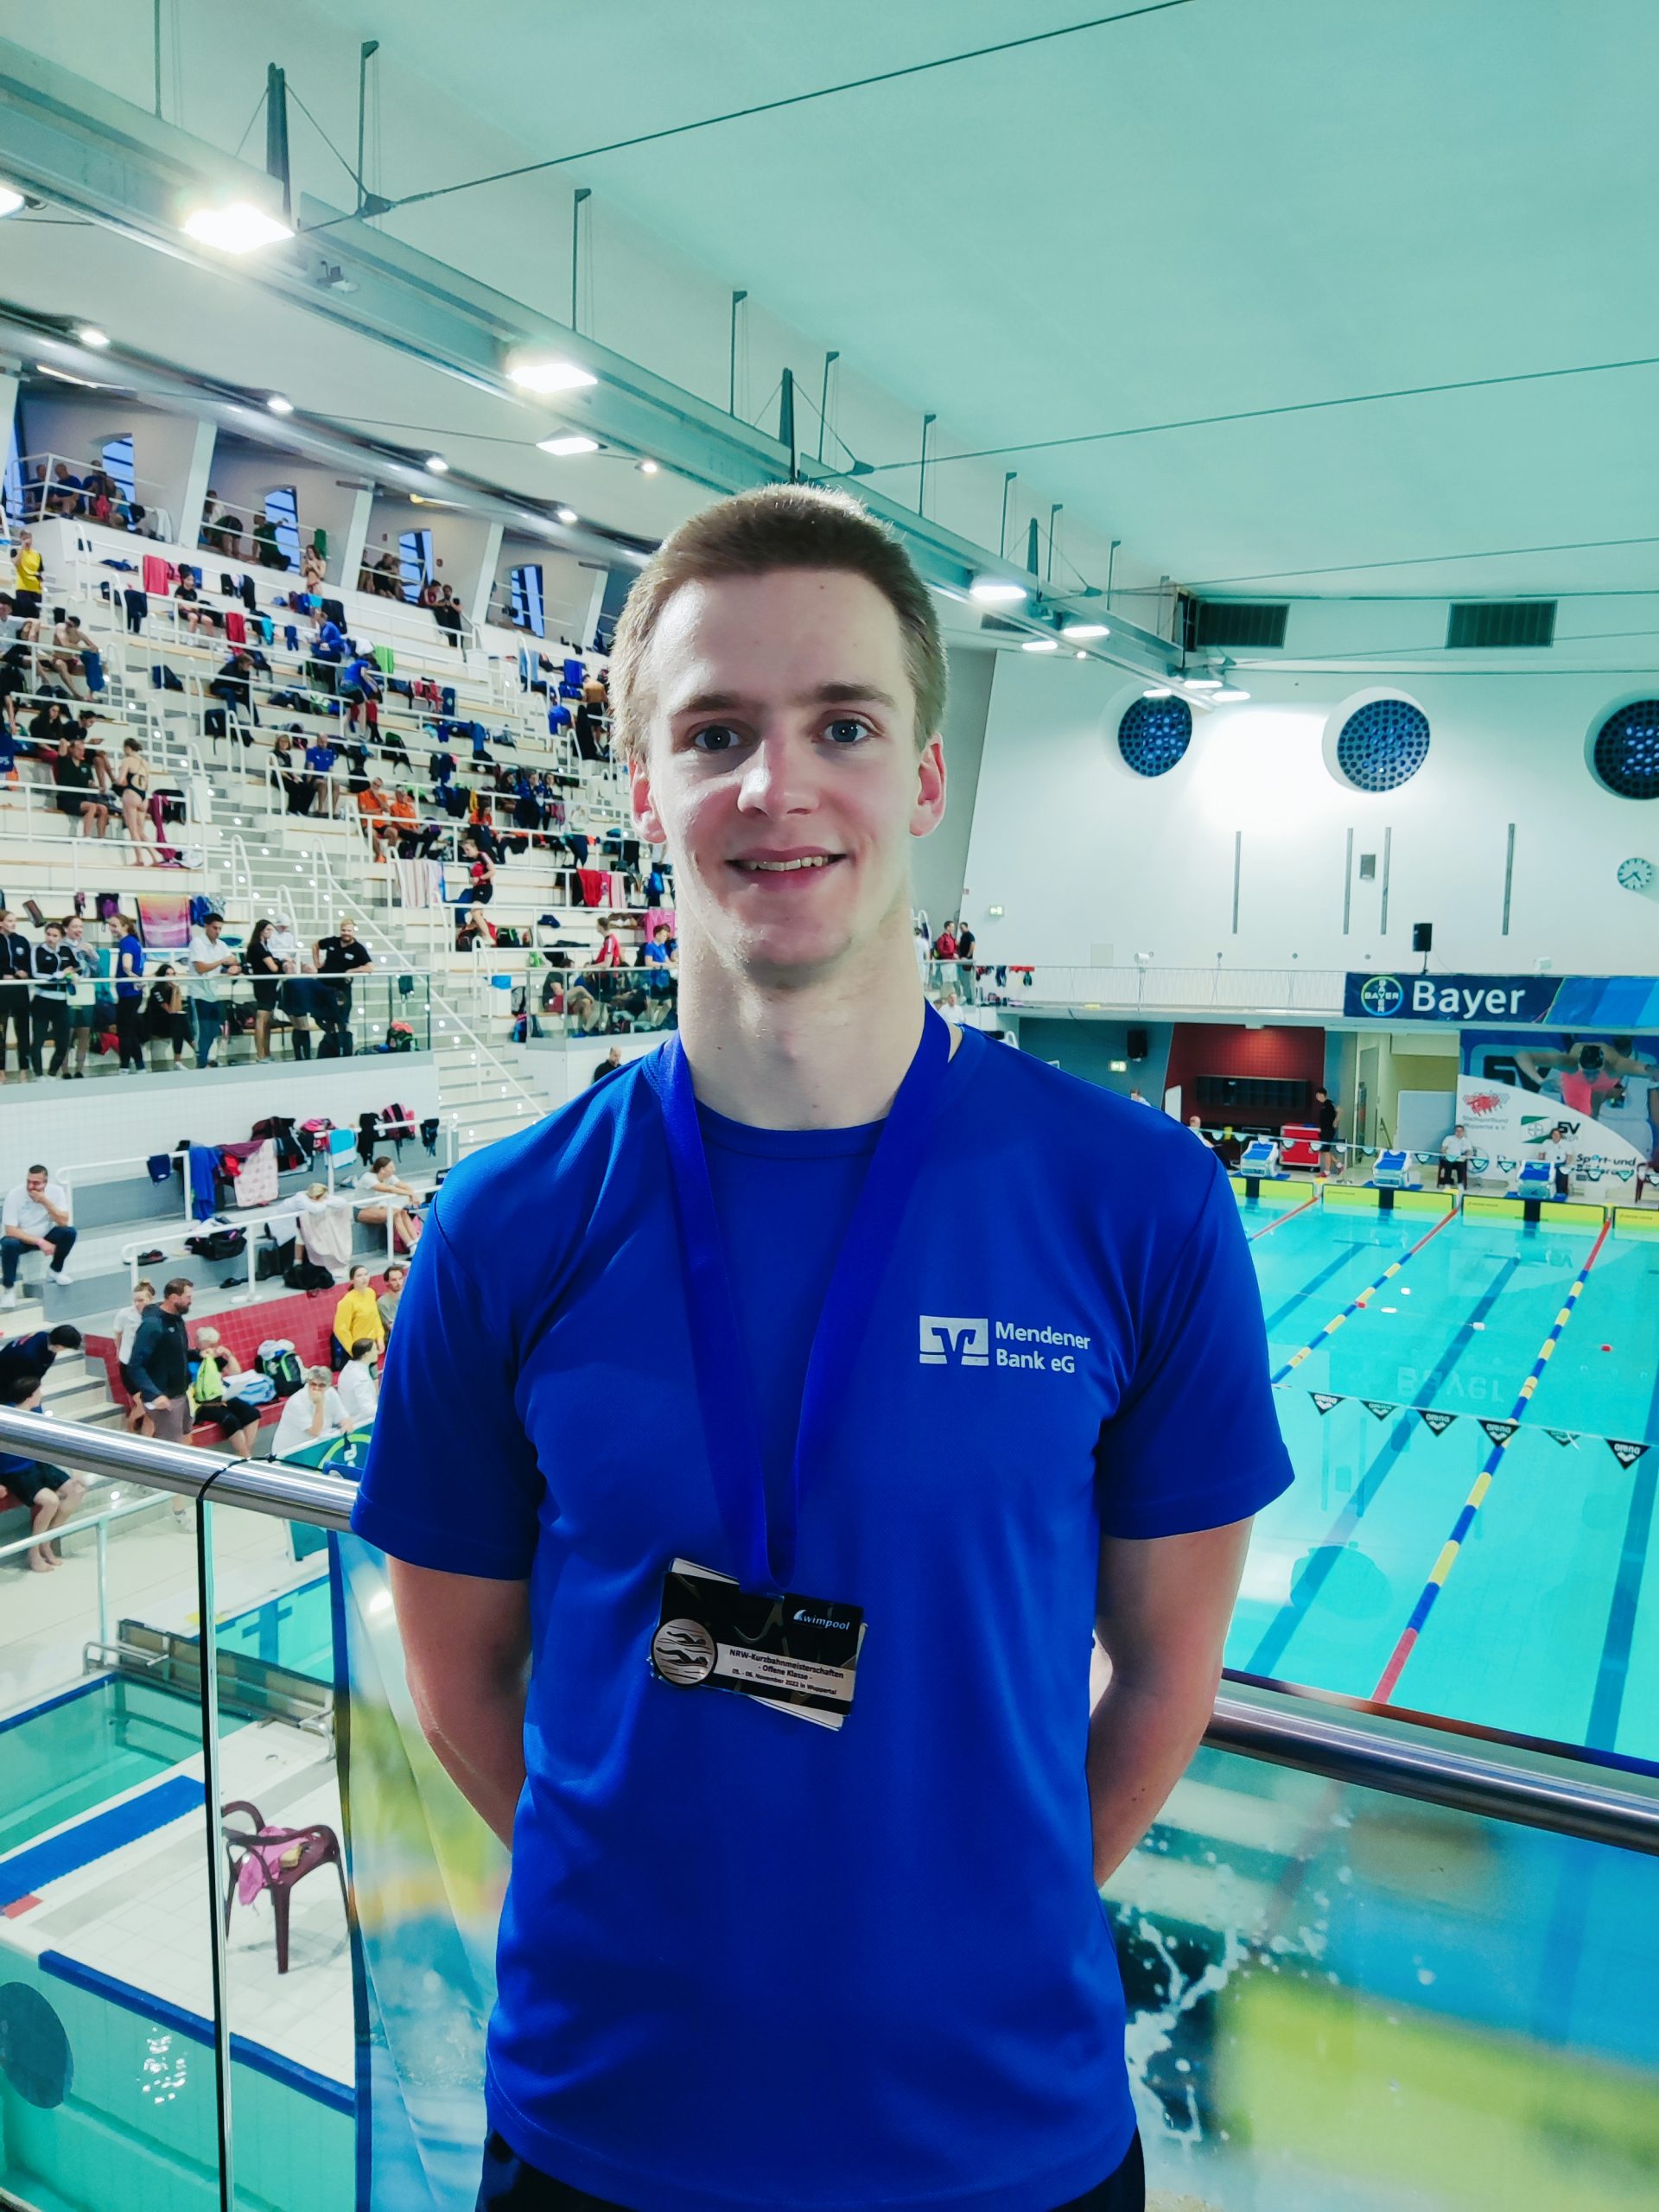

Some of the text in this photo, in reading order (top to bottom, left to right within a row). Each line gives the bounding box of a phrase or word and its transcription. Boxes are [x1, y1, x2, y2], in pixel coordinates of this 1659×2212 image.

[1413, 980, 1526, 1020] Bayer
[995, 1321, 1090, 1350] Mendener
[996, 1348, 1075, 1373] Bank eG
[1426, 1413, 1451, 1423] arena
[1486, 1423, 1512, 1434] arena
[1614, 1443, 1641, 1455] arena
[762, 1664, 785, 1676] Offene
[786, 1669, 809, 1680] Klasse
